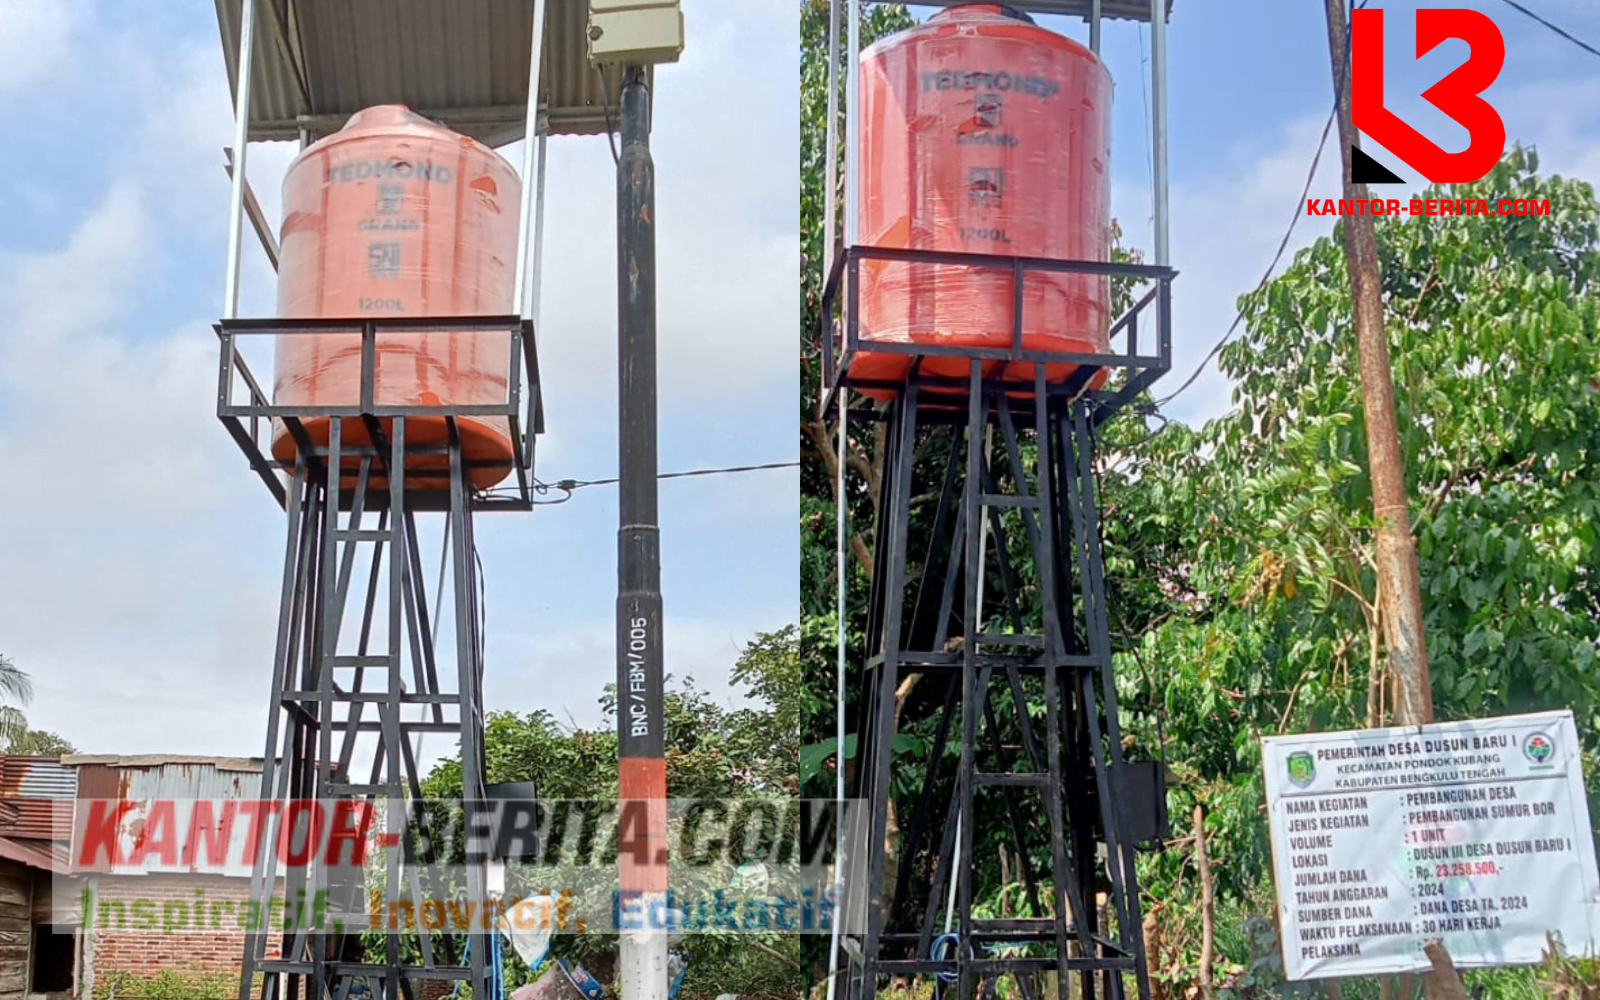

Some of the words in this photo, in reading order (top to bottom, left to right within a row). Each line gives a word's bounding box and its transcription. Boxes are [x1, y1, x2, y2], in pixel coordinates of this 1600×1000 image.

[330, 161, 453, 185] TEDMOND
[357, 218, 421, 232] GRAND
[959, 227, 1011, 243] 1200L
[358, 297, 406, 312] 1200L
[627, 617, 649, 737] BNC/FBM/005
[1317, 745, 1385, 761] PEMERINTAH
[1389, 742, 1421, 756] DESA
[1425, 739, 1468, 753] DUSUN
[1474, 735, 1507, 749] BARU
[1512, 735, 1517, 746] I
[1337, 761, 1402, 774] KECAMATAN
[1405, 757, 1450, 769] PONDOK
[1454, 753, 1501, 766] KUBANG
[1335, 776, 1398, 788] KABUPATEN
[1401, 771, 1458, 784] BENGKULU
[1461, 768, 1506, 779] TENGAH
[1286, 801, 1317, 815] NAMA
[1319, 796, 1368, 812] KEGIATAN
[1407, 789, 1486, 806] PEMBANGUNAN
[1489, 786, 1517, 800] DESA
[1288, 818, 1318, 833] JENIS
[1320, 814, 1369, 830] KEGIATAN
[1409, 807, 1489, 824] PEMBANGUNAN
[1491, 804, 1530, 819] SUMUR
[1533, 802, 1556, 816] BOR
[1290, 835, 1333, 850] VOLUME
[1412, 830, 1418, 843] 1
[1421, 828, 1446, 842] UNIT
[1292, 853, 1329, 869] LOKASI
[1413, 845, 1449, 861] DUSUN
[1451, 844, 1464, 858] III
[1466, 842, 1494, 857] DESA
[1496, 840, 1533, 855] DUSUN
[1535, 837, 1564, 852] BARU
[1566, 837, 1572, 851] I
[1294, 870, 1337, 887] JUMLAH
[1340, 868, 1368, 883] DANA
[1416, 865, 1434, 881] Rp.
[1295, 890, 1330, 905] TAHUN
[1333, 886, 1388, 902] ANGGARAN
[1418, 883, 1445, 897] 2024
[1298, 907, 1341, 923] SUMBER
[1344, 905, 1373, 920] DANA
[1420, 900, 1449, 915] DANA
[1451, 898, 1479, 913] DESA
[1481, 897, 1498, 911] TA.
[1501, 896, 1529, 910] 2024
[1300, 926, 1336, 941] WAKTU
[1339, 921, 1413, 938] PELAKSANAAN
[1422, 920, 1436, 934] 30
[1438, 918, 1464, 933] HARI
[1467, 916, 1502, 931] KERJA
[1301, 943, 1361, 960] PELAKSANA
